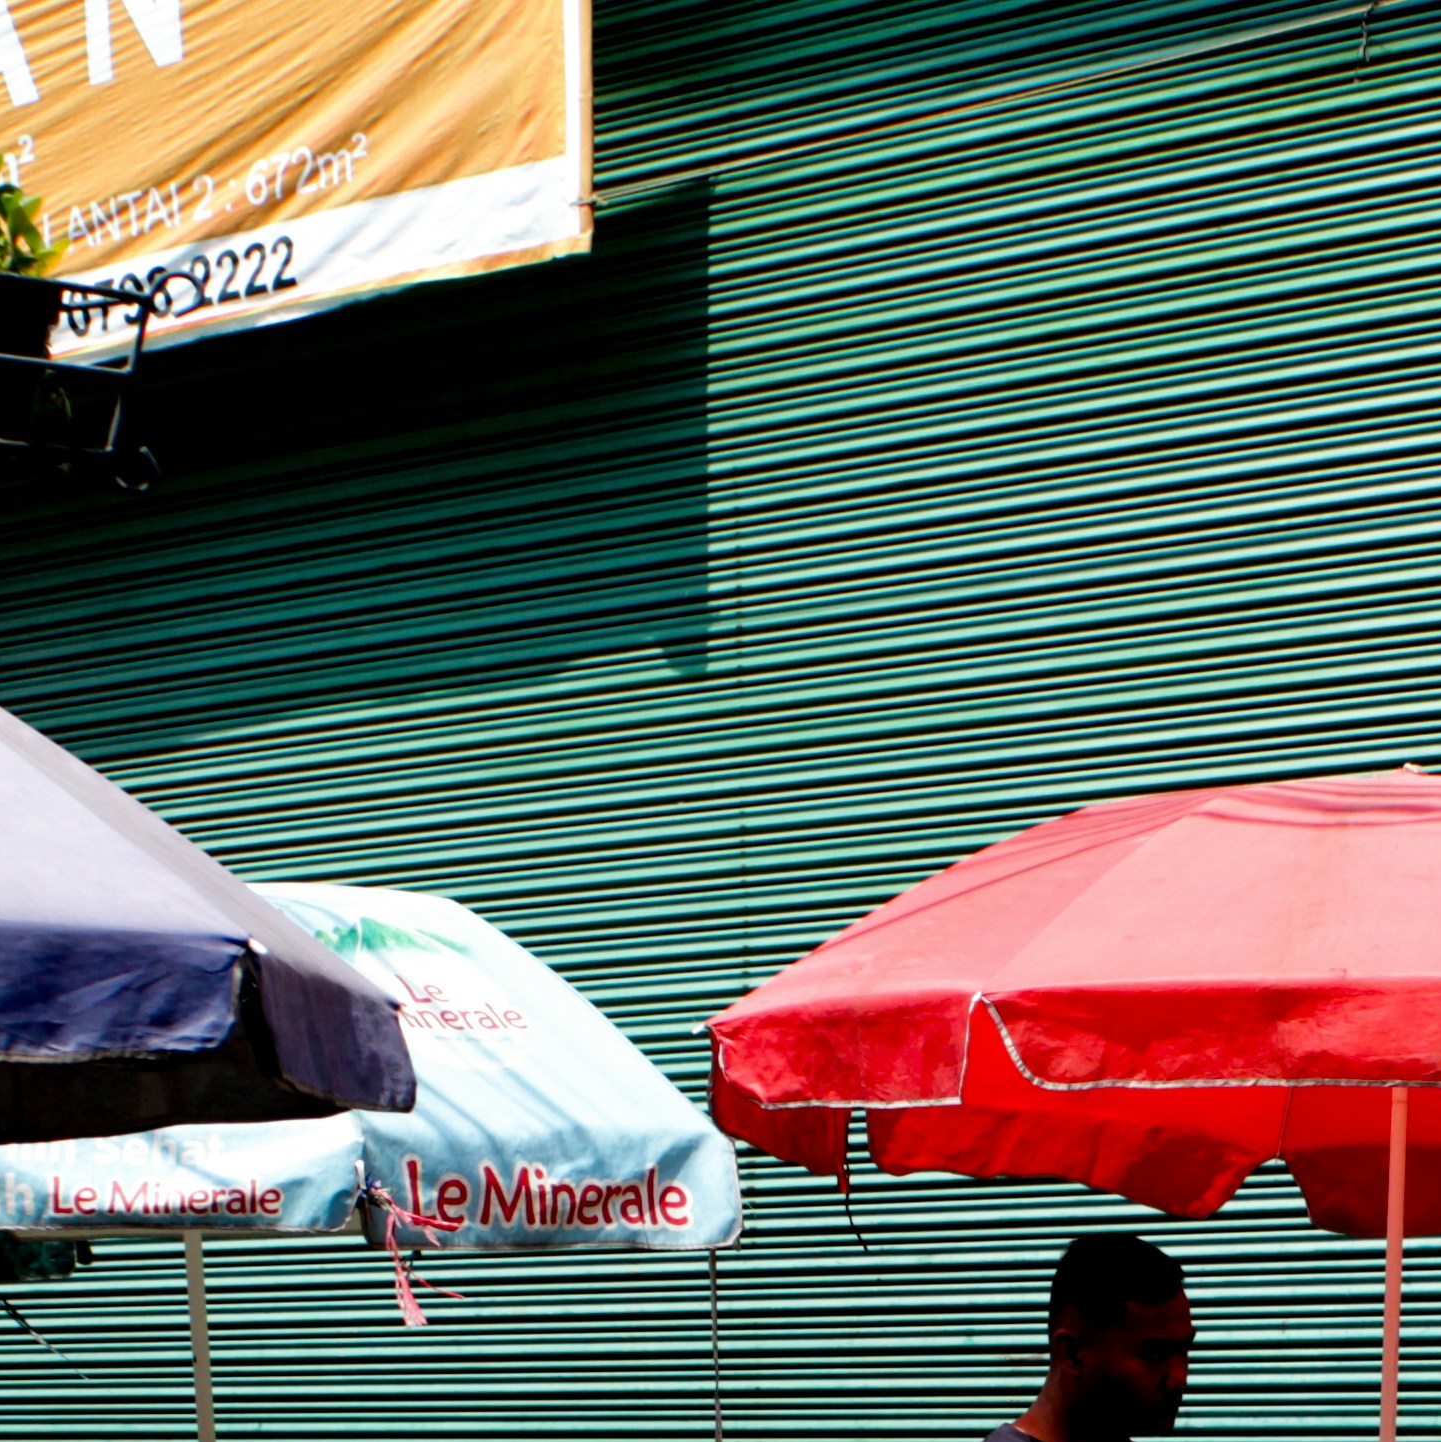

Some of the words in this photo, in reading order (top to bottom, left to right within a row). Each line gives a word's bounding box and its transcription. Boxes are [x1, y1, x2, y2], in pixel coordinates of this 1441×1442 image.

[394, 973, 450, 1004] Le
[52, 1175, 97, 1216] Le
[107, 1178, 283, 1217] Minerale
[405, 1157, 469, 1228] Le
[478, 1162, 690, 1228] Minerale
